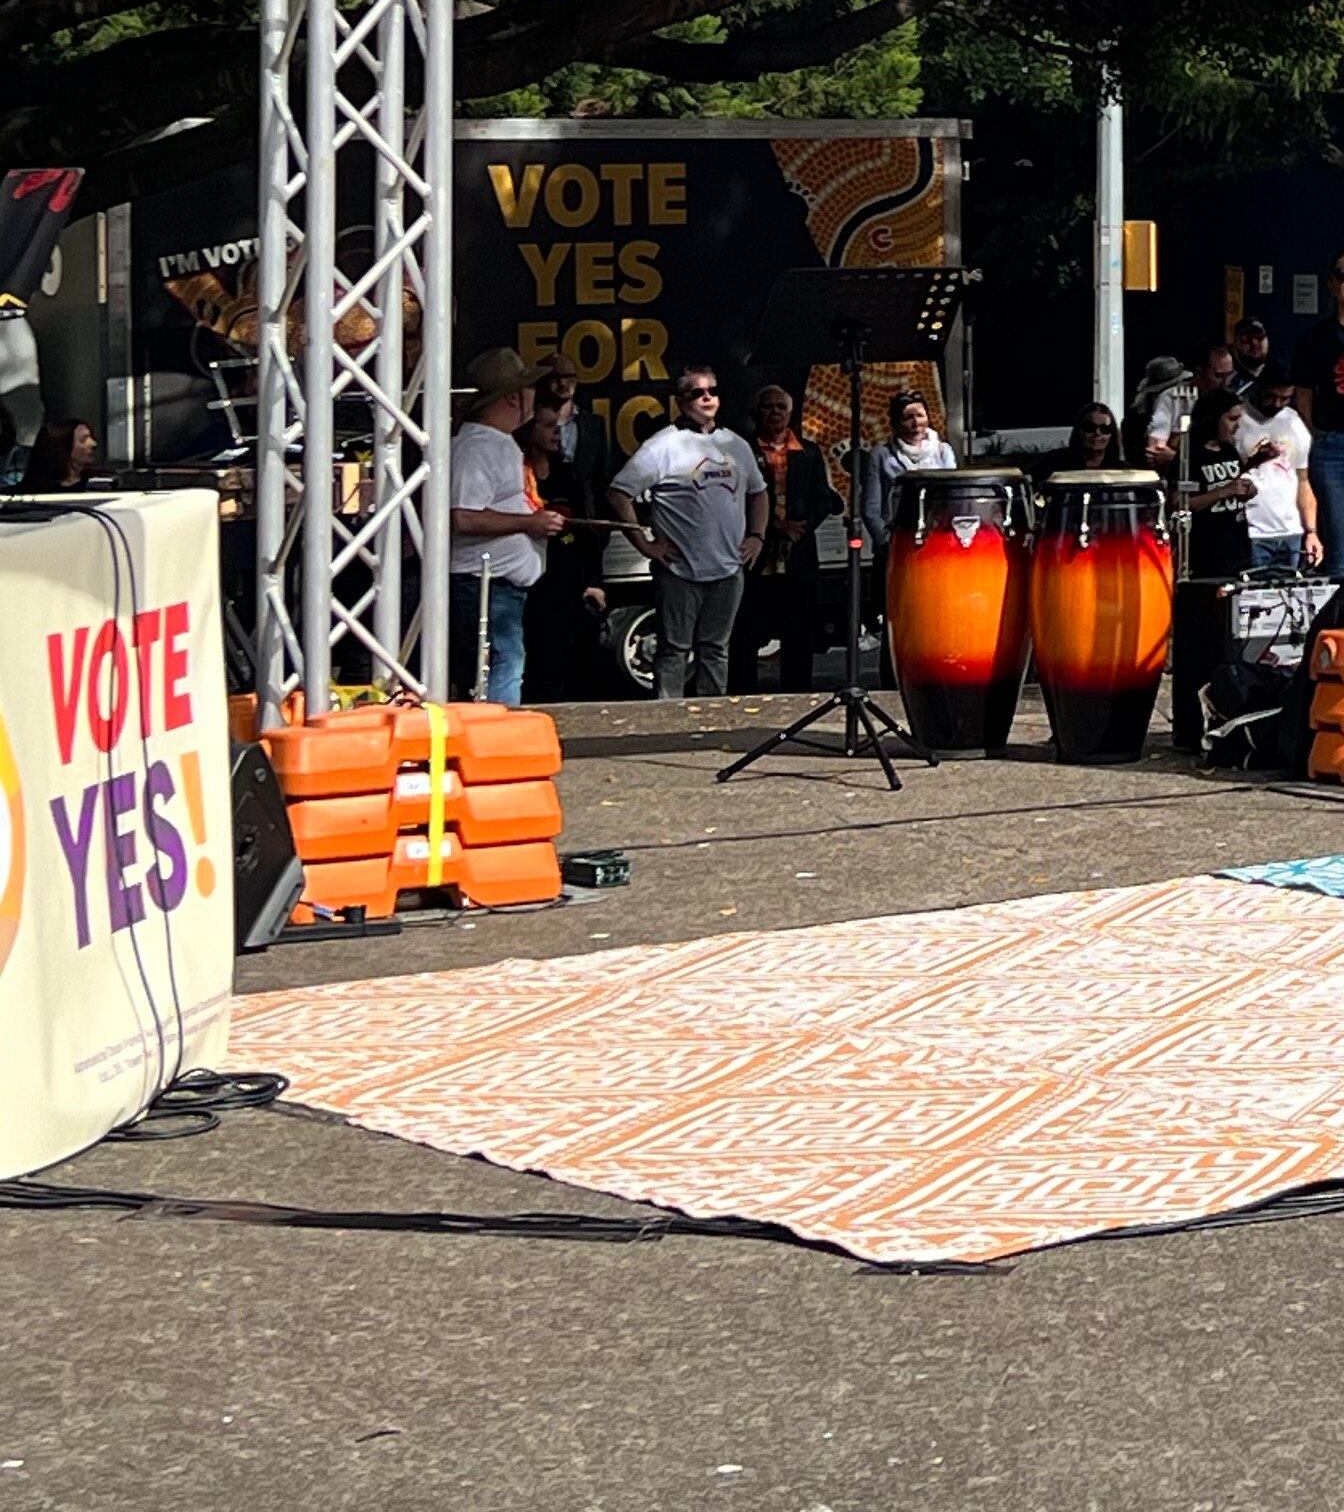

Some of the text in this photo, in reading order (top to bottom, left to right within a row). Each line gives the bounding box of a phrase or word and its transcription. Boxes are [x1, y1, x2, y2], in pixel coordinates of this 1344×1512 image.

[487, 162, 688, 228] VOTE
[158, 251, 200, 278] I'M
[517, 240, 664, 307] YES
[517, 318, 671, 384] FOR
[46, 600, 193, 766] VOTE
[49, 749, 217, 950] YES!
